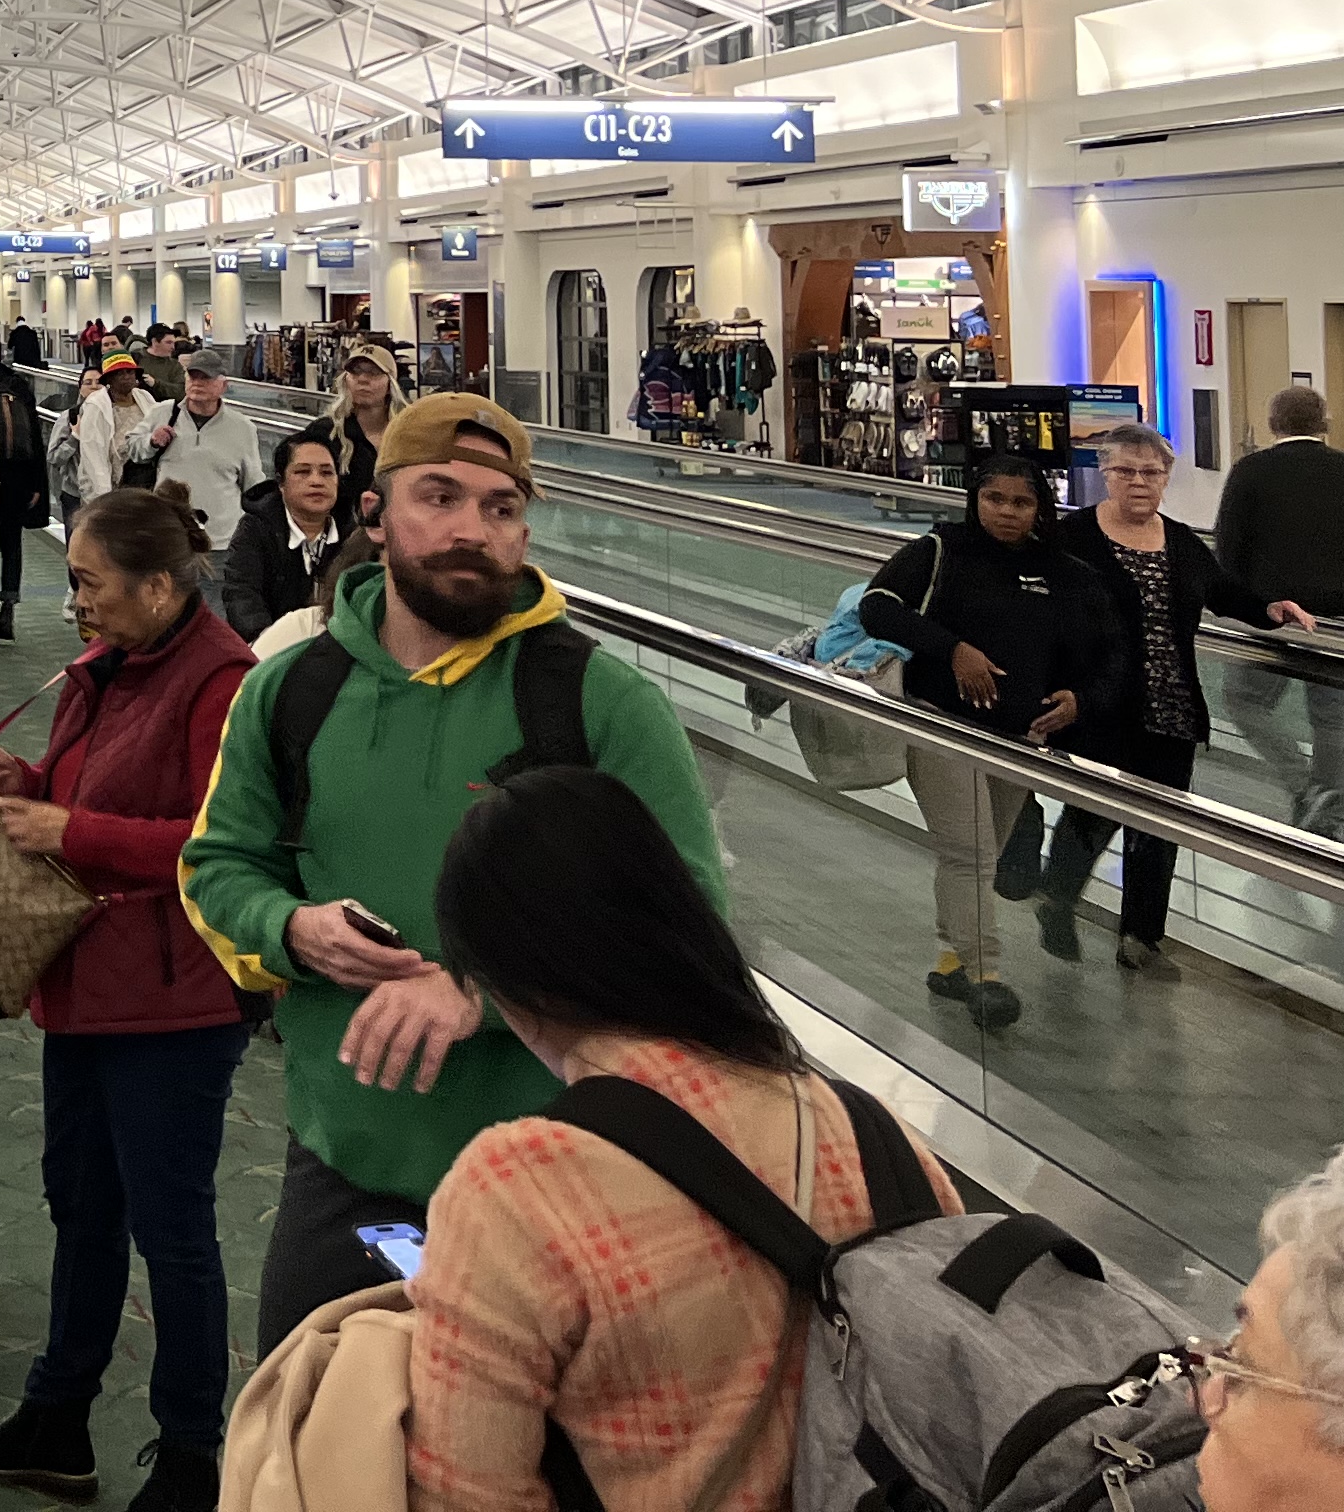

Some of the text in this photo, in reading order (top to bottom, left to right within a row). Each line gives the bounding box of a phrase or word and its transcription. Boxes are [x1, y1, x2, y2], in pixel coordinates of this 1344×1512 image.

[583, 114, 673, 143] C11-C23
[11, 237, 43, 247] C13-C23
[217, 254, 237, 268] C12
[73, 266, 88, 276] C14
